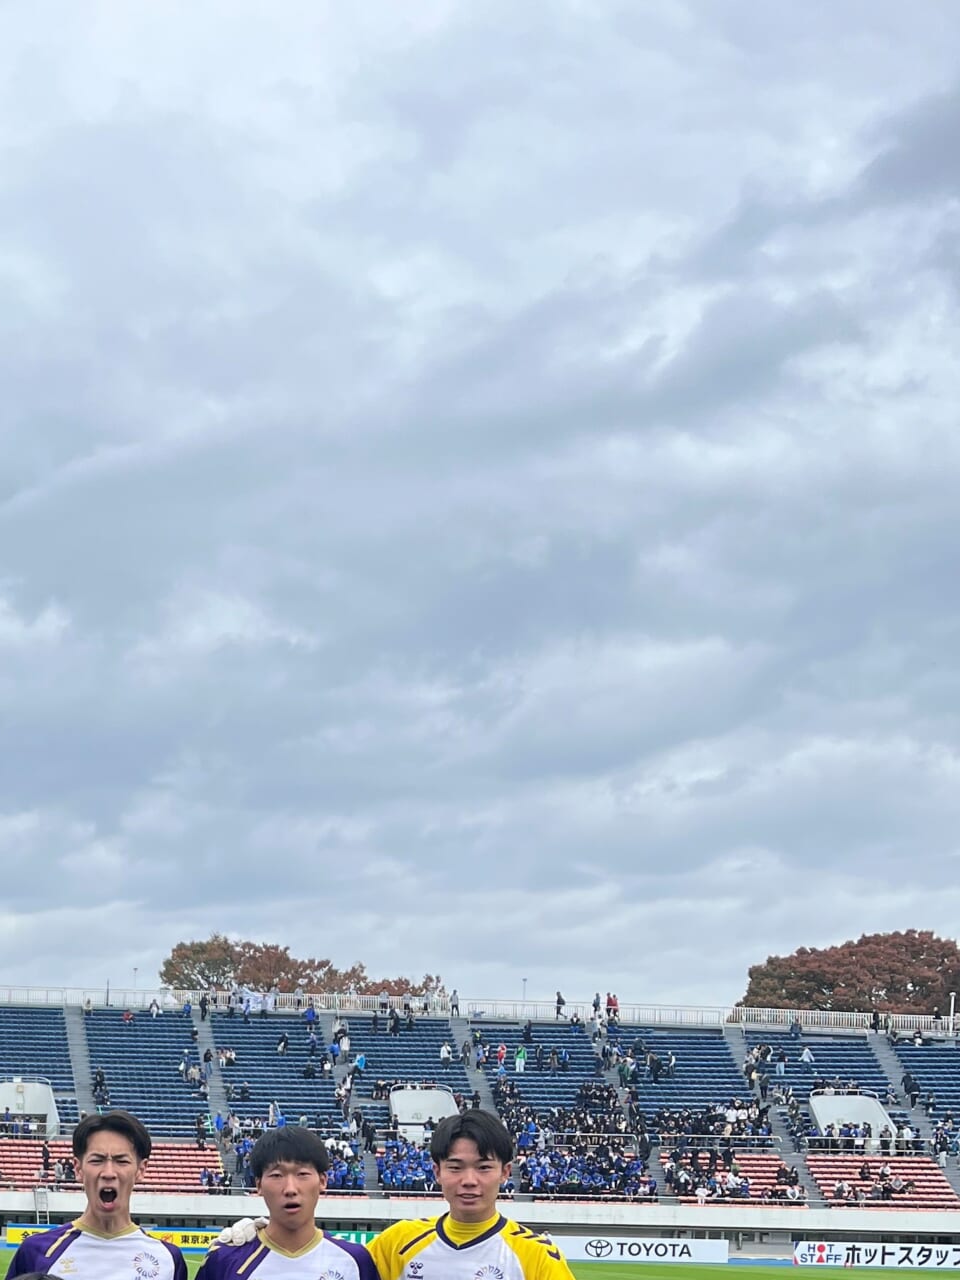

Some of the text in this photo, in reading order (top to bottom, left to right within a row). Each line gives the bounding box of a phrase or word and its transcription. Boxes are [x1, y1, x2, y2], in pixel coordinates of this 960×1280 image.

[180, 1234, 220, 1245] 東京決
[616, 1242, 693, 1258] TOYOTA
